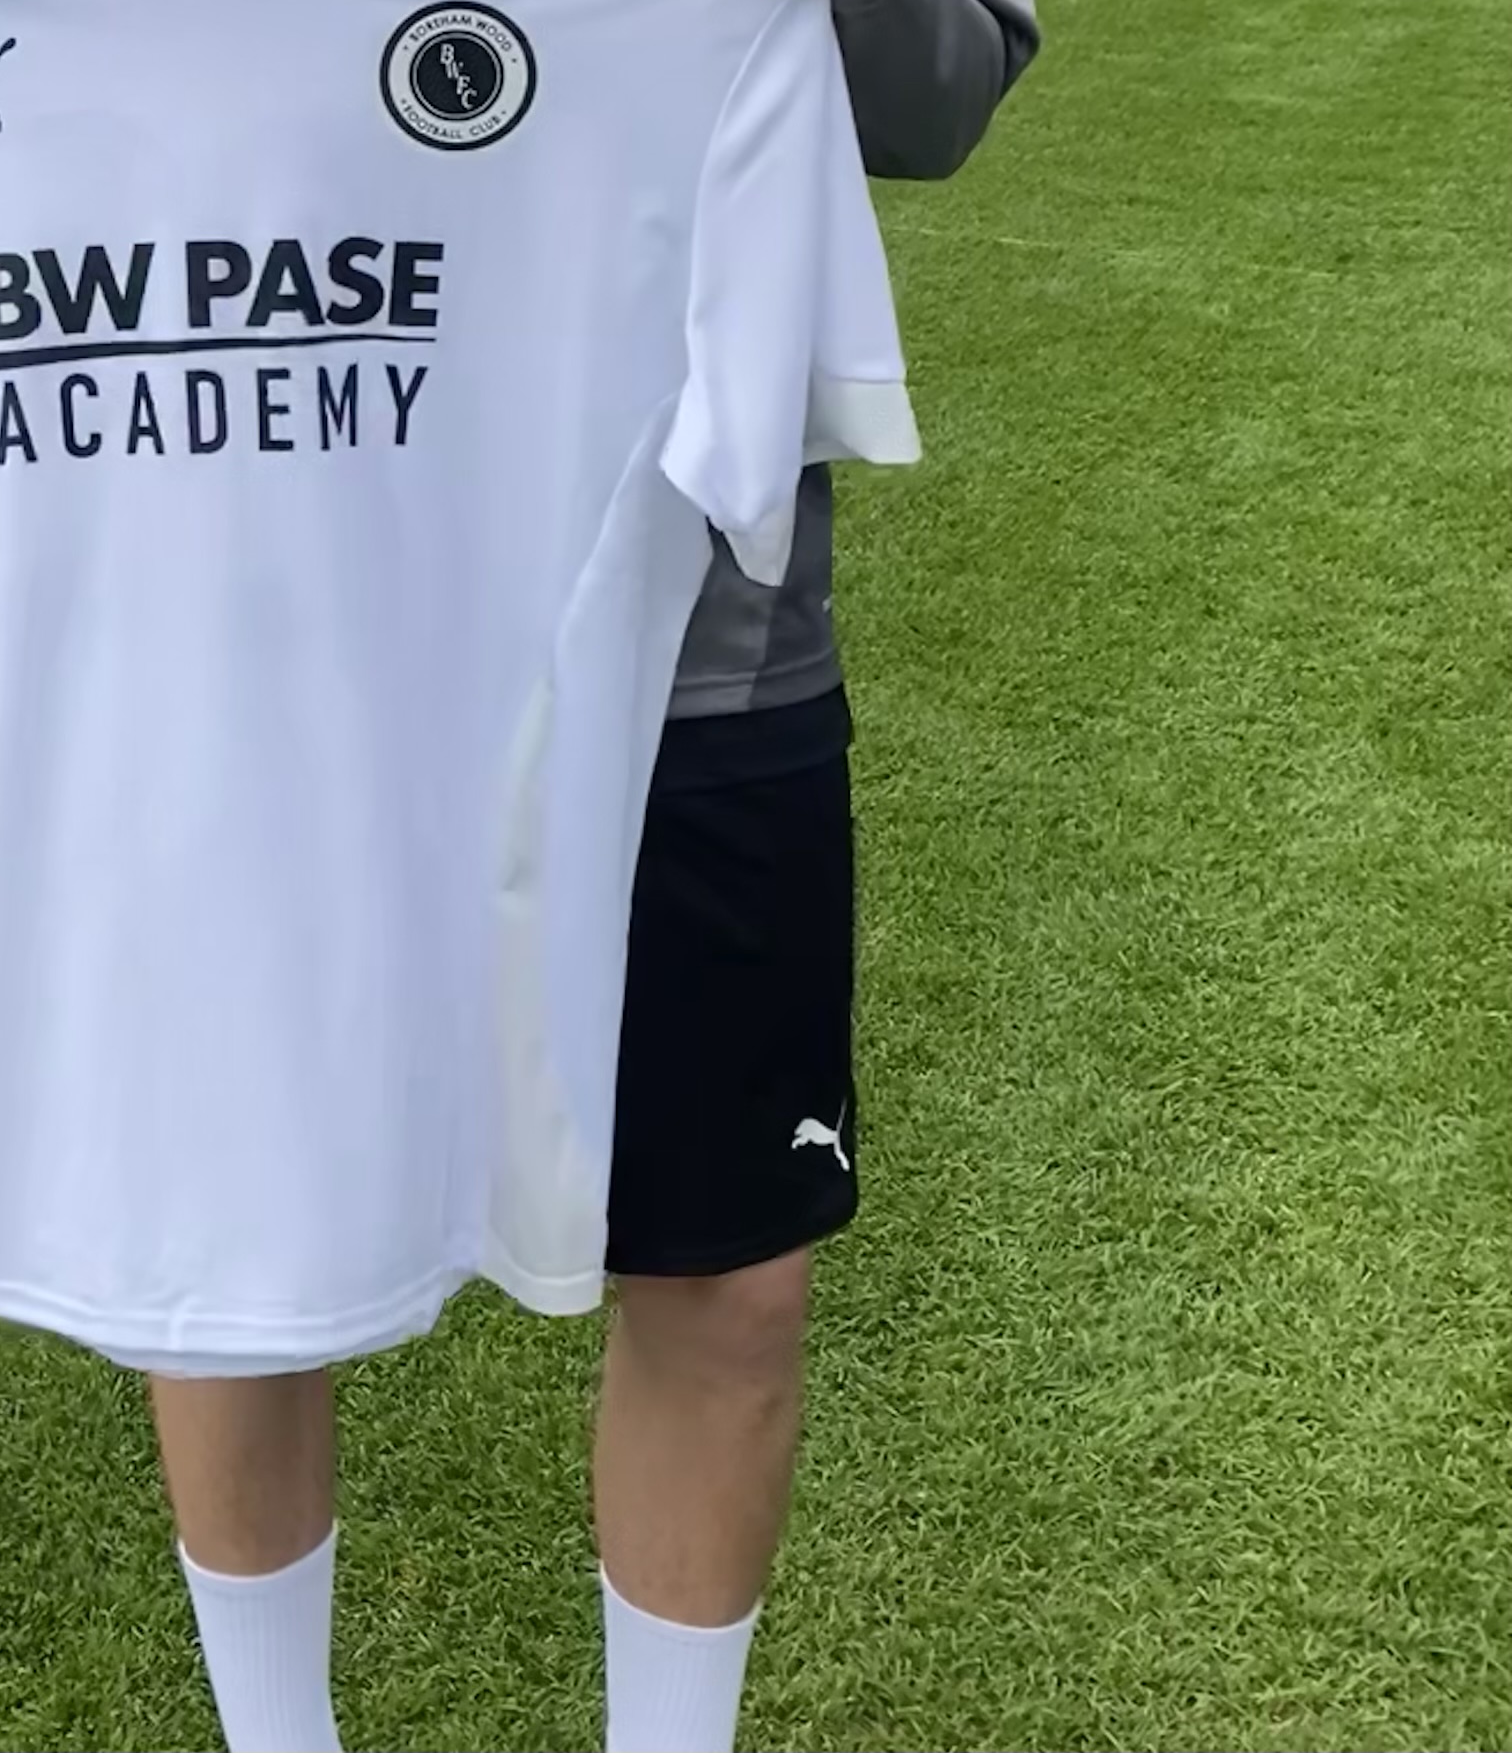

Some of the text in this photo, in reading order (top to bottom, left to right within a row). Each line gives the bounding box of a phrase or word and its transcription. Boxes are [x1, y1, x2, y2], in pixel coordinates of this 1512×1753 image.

[475, 19, 513, 52] WOOD
[401, 105, 502, 140] FOOTBALL CLUB
[185, 236, 445, 328] PASE
